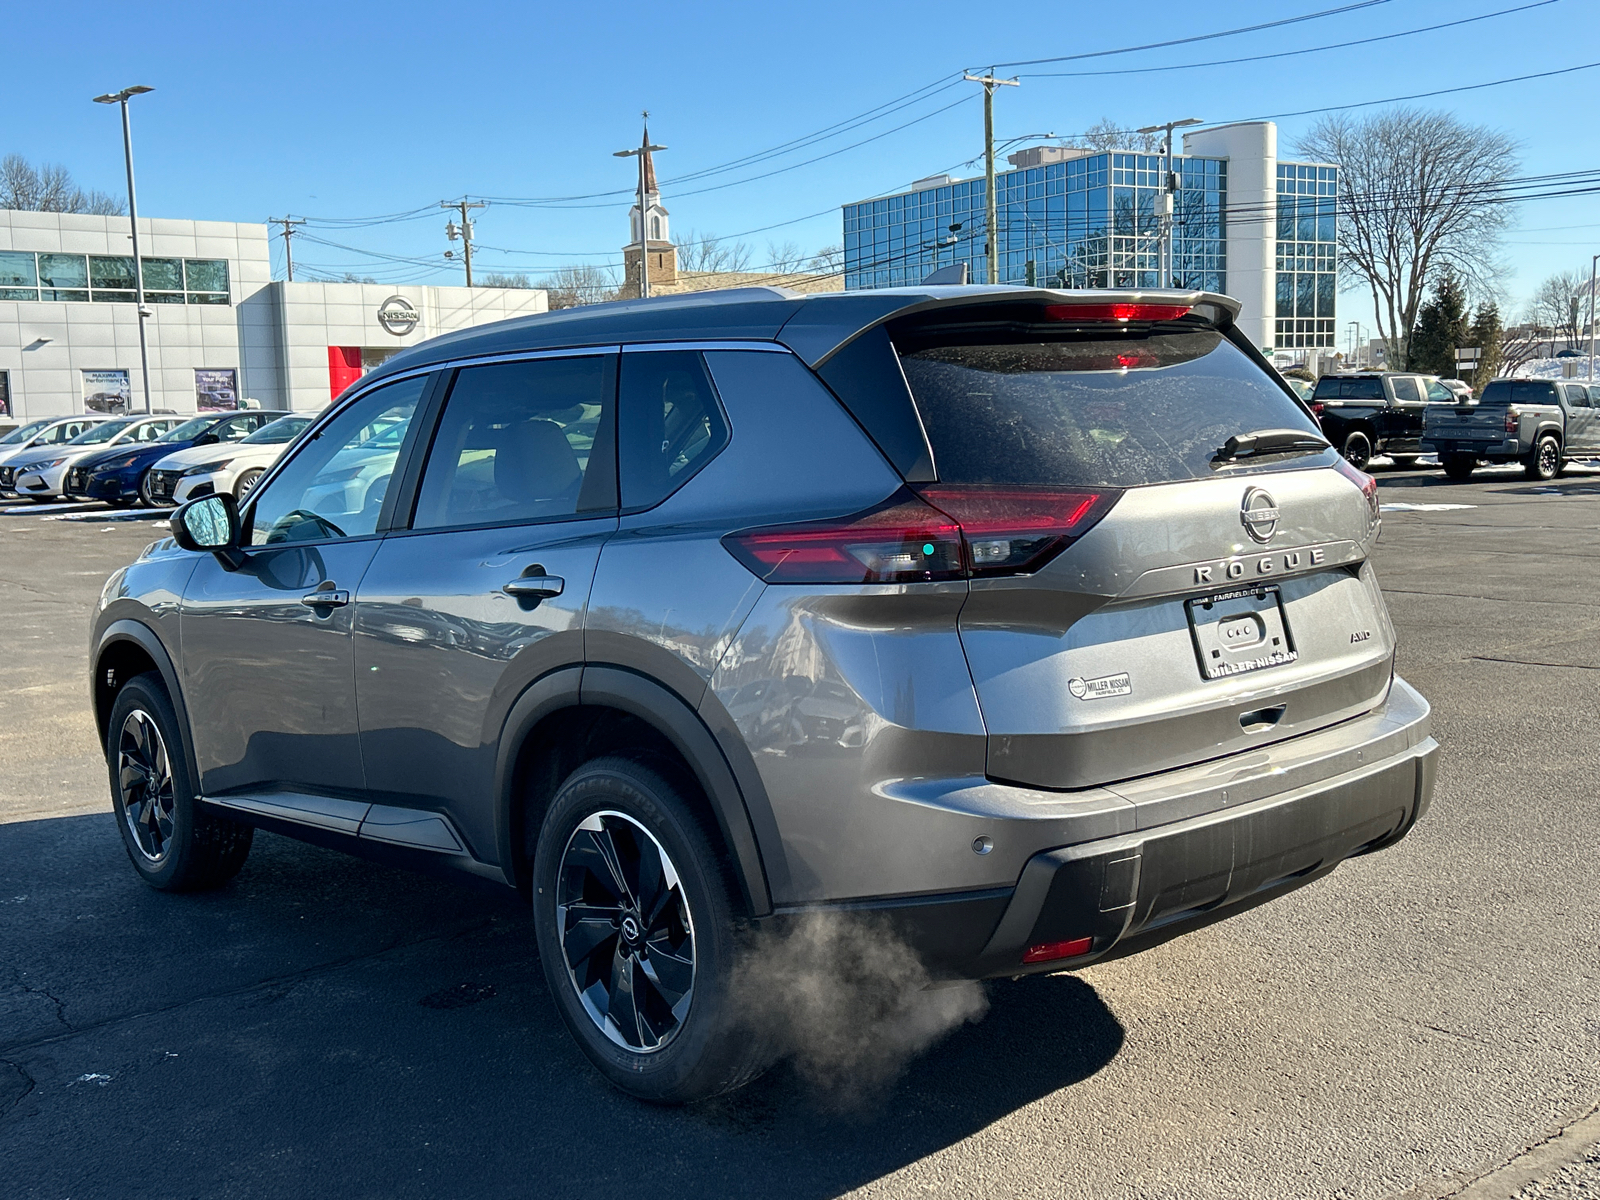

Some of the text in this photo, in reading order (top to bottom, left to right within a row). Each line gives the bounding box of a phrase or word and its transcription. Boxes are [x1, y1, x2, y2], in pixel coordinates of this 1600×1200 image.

[1245, 510, 1281, 522] NISSAN
[1194, 548, 1325, 585] ROGUE
[1350, 630, 1371, 644] AWD
[1208, 651, 1298, 679] MILLER NISSAN
[1086, 678, 1130, 692] MILLER NISSAN
